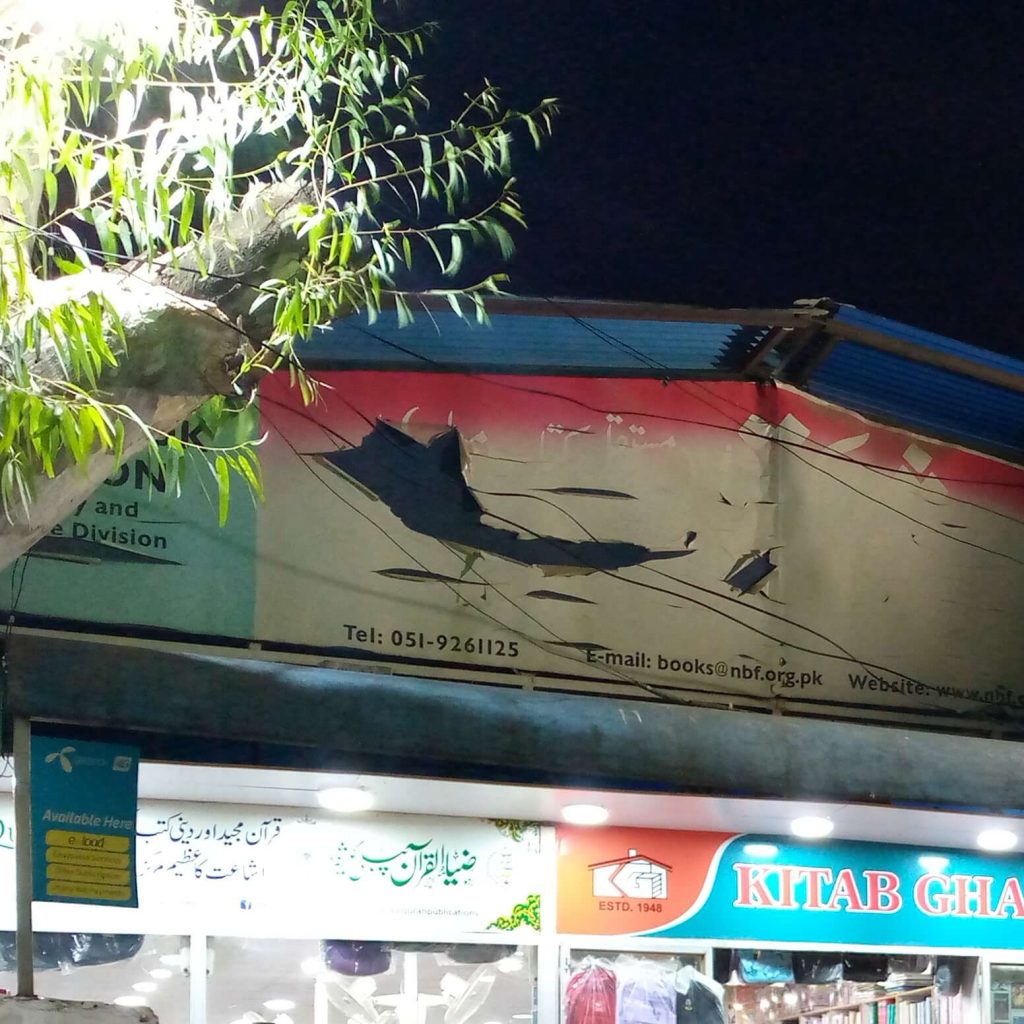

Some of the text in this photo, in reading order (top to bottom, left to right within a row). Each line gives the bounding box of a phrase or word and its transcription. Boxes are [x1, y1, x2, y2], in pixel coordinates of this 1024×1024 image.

[95, 501, 139, 519] and
[72, 522, 167, 550] Division
[343, 624, 383, 645] Tel:
[586, 650, 823, 688] E-mail: books@nbf.org.pk
[848, 673, 930, 697] Website:
[42, 809, 134, 830] Available Here
[732, 862, 902, 915] KITAB
[599, 901, 663, 913] ESTD. 1948
